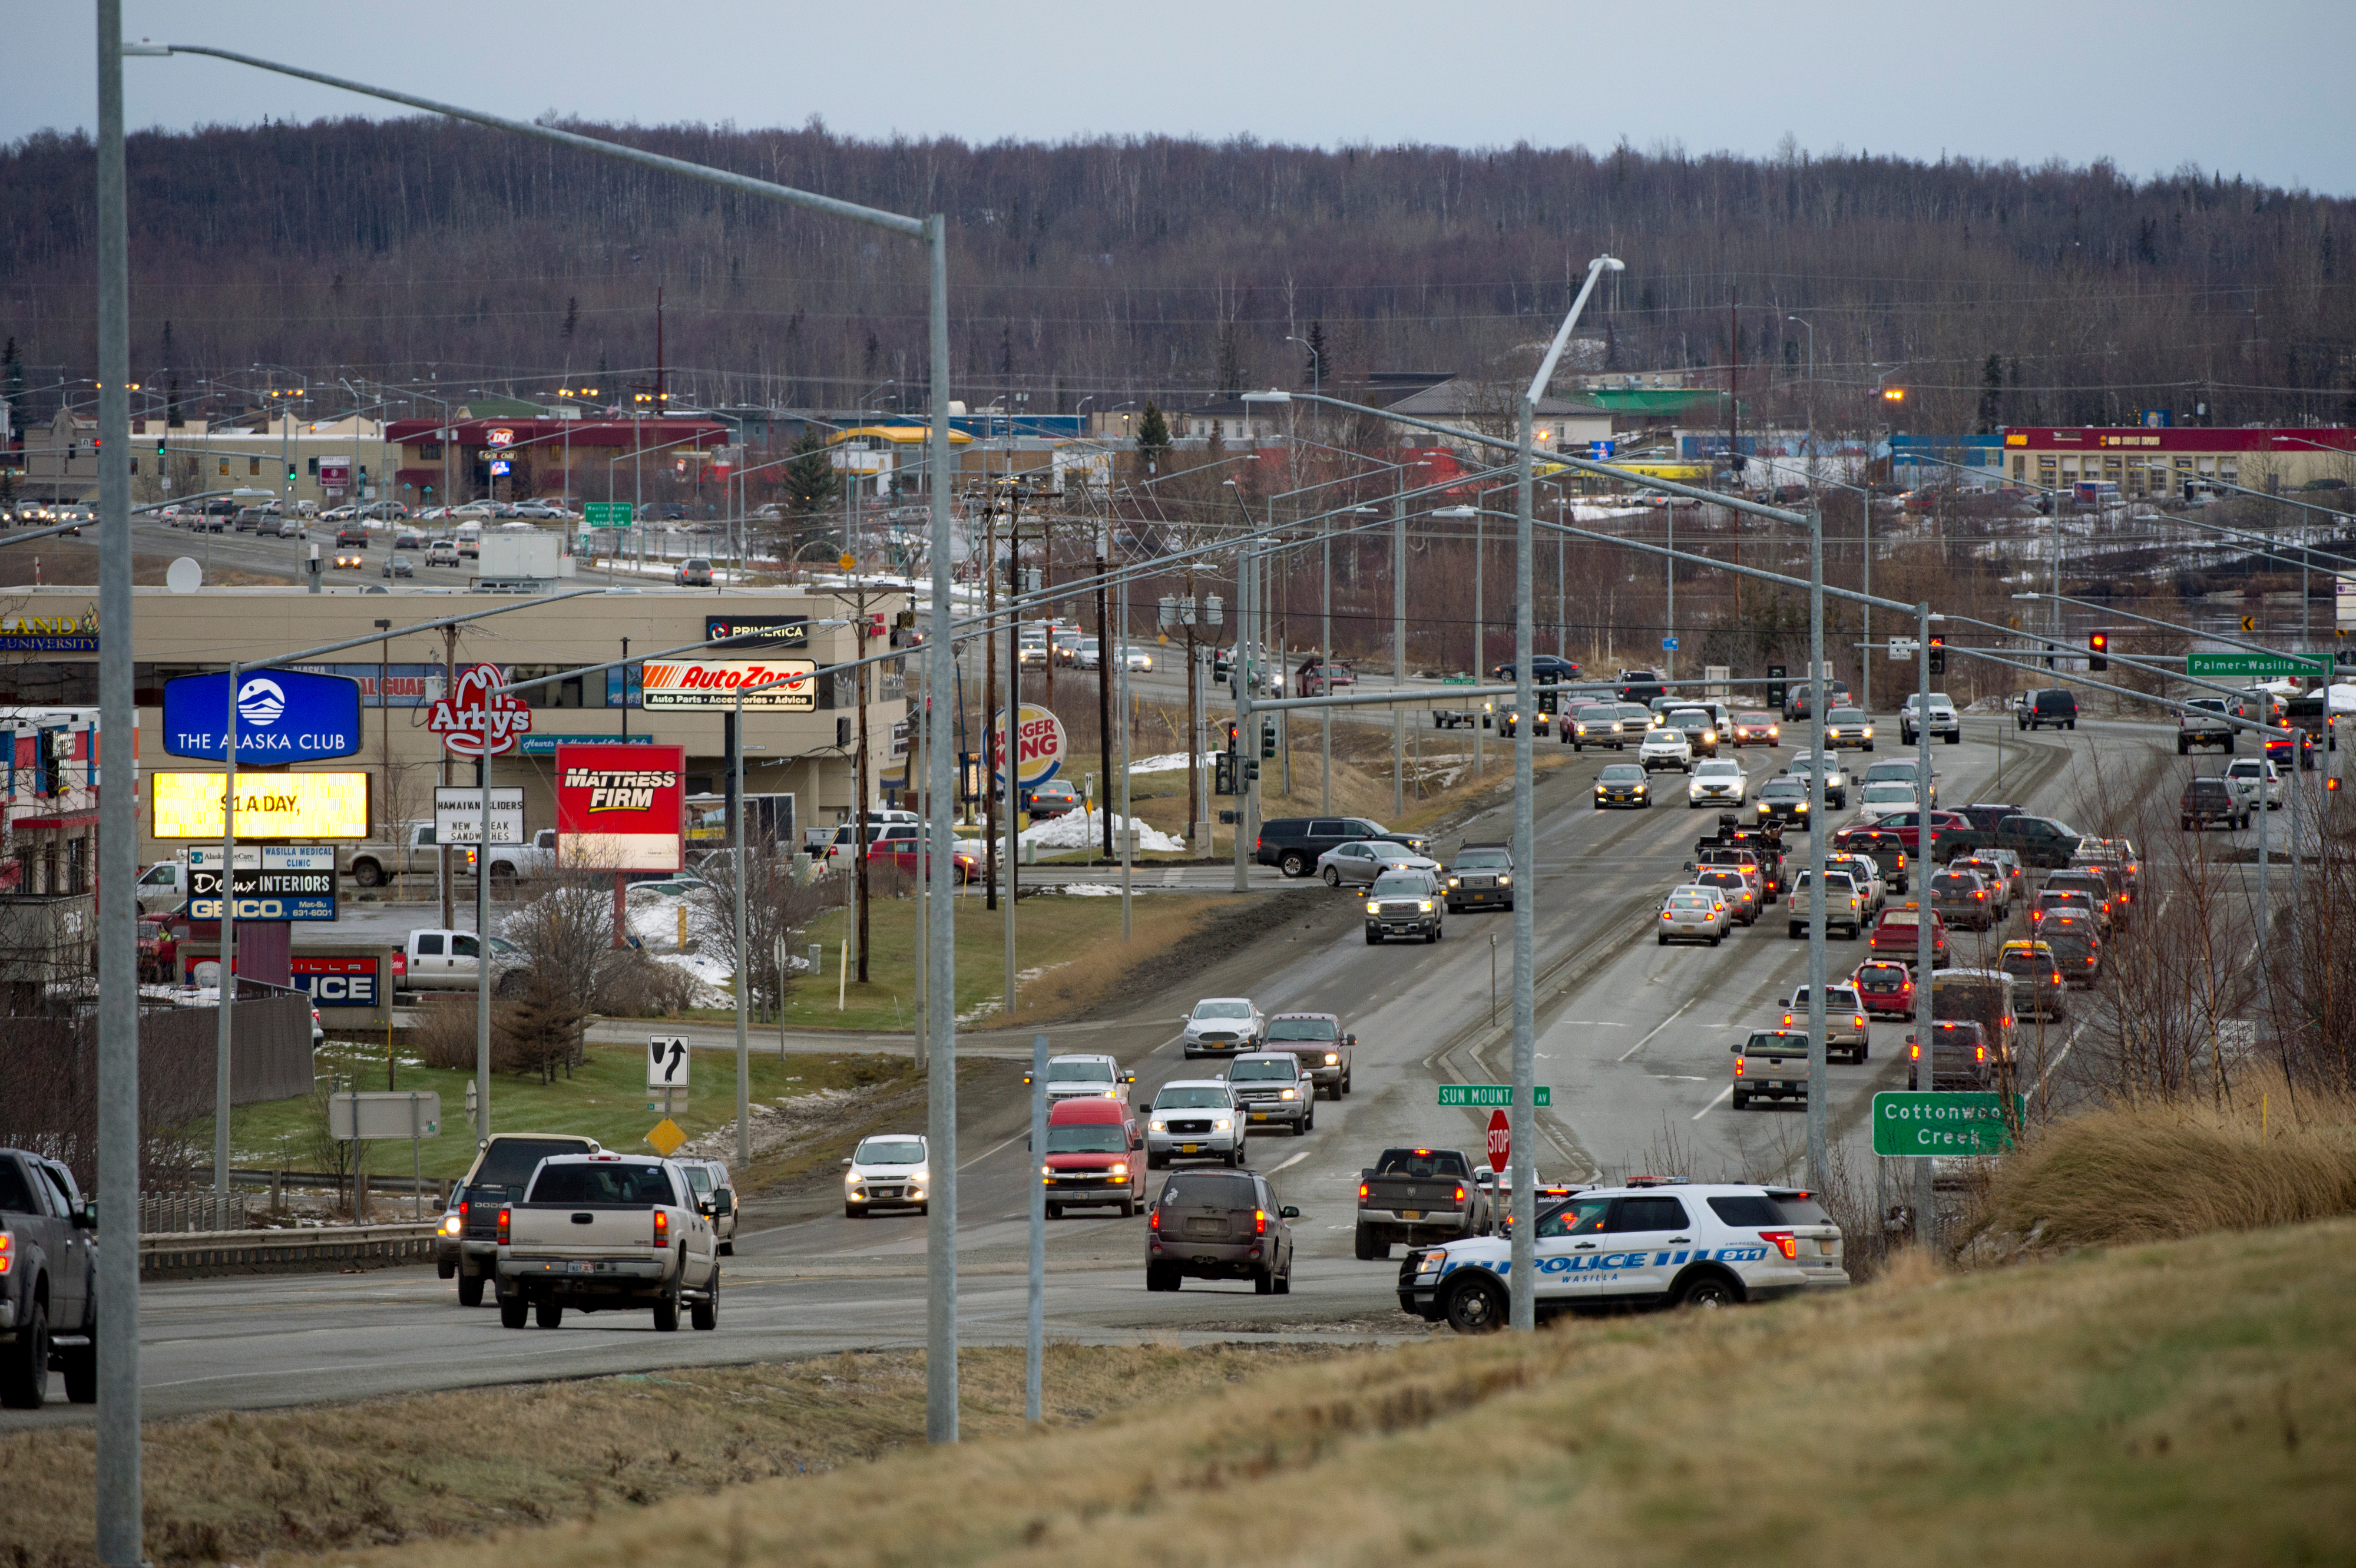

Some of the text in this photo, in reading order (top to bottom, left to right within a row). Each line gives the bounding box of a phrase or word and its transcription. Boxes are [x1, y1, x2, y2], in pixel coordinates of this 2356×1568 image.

[493, 433, 511, 444] DQ
[2108, 436, 2160, 445] AUTO SERVICE EXPERTS
[2195, 660, 2294, 670] Palmer-Wasilla
[679, 666, 806, 690] AutoZone
[651, 695, 674, 703] Auto
[677, 695, 701, 703] Parts
[775, 695, 807, 703] Advice
[431, 701, 529, 738] Arby's
[178, 734, 211, 749] THE
[299, 734, 345, 749] CLUB
[524, 739, 554, 747] Hearts
[565, 768, 676, 788] MATTRESS
[590, 788, 654, 807] FIRM
[247, 796, 259, 811] A
[264, 796, 301, 815] DAY,
[259, 876, 330, 892] INTERIORS
[191, 900, 283, 918] GEICO
[1442, 1089, 1465, 1103] SUN
[1537, 1094, 1547, 1103] AV
[1488, 1129, 1508, 1154] STOP
[1918, 1129, 1980, 1144] Creek
[1722, 1249, 1763, 1260] 911
[1562, 1274, 1617, 1283] WASILLA
